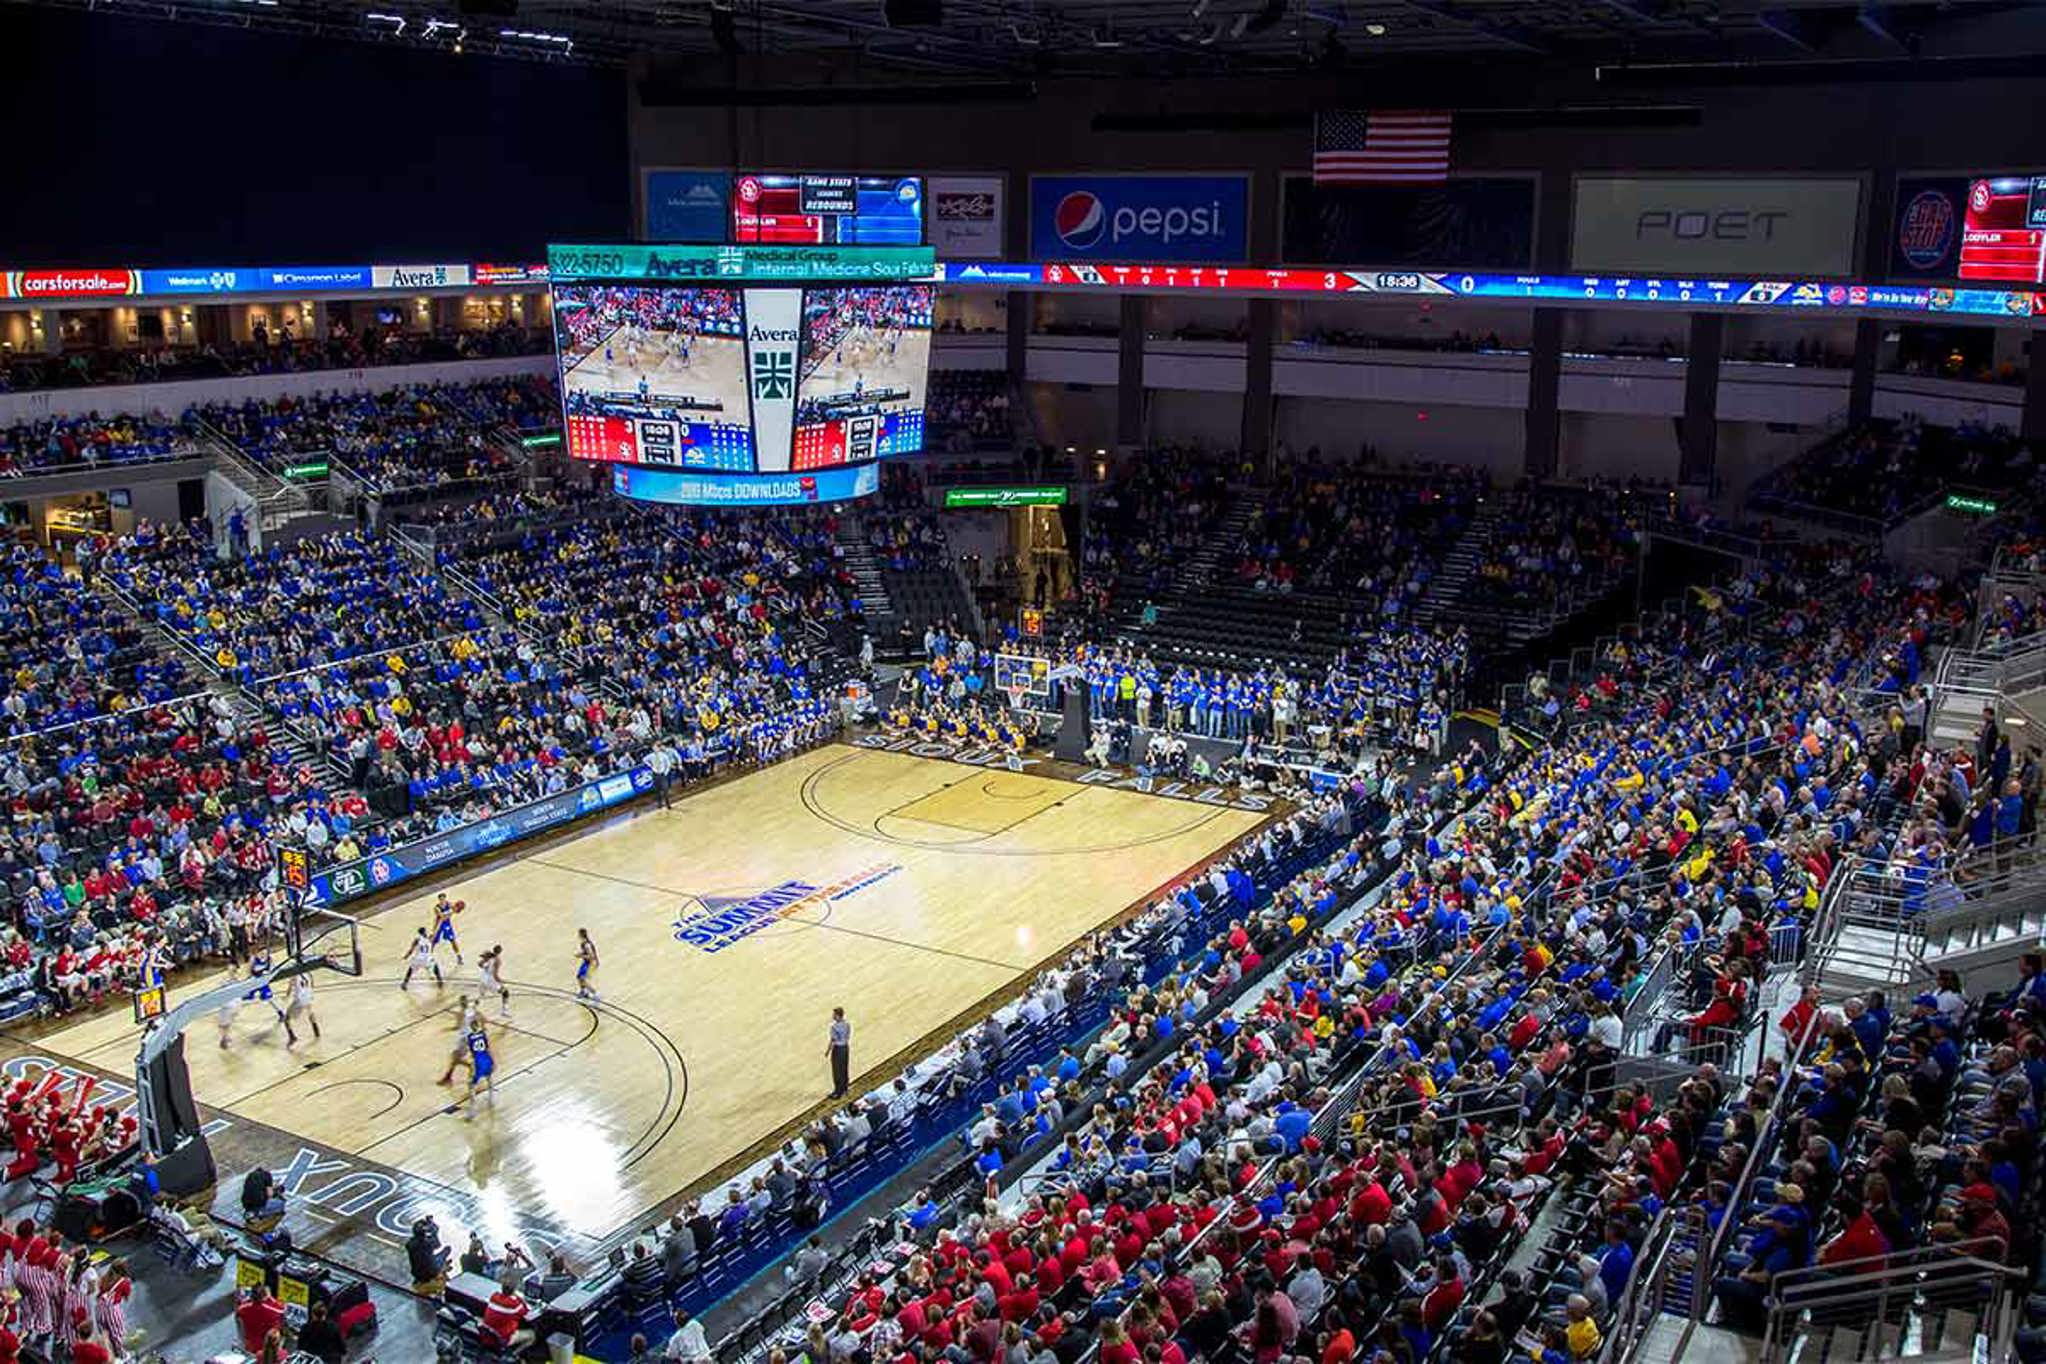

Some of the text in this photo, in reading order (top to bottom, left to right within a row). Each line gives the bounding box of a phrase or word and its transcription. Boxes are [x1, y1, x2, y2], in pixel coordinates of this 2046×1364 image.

[1113, 200, 1219, 243] pepsi
[1637, 211, 1791, 240] POET
[647, 251, 719, 276] Avera
[800, 250, 838, 263] Group
[753, 262, 808, 275] Internal
[393, 269, 434, 287] Avera
[1324, 273, 1336, 289] 3
[1461, 276, 1474, 293] 0
[1585, 287, 1595, 298] 0
[1617, 288, 1626, 299] 0
[1648, 289, 1658, 300] 0
[1681, 290, 1691, 301] 0
[750, 325, 797, 341] Avera
[681, 423, 690, 437] 0
[734, 480, 800, 498] DOWNLOADS
[674, 880, 822, 946] SUMMIT
